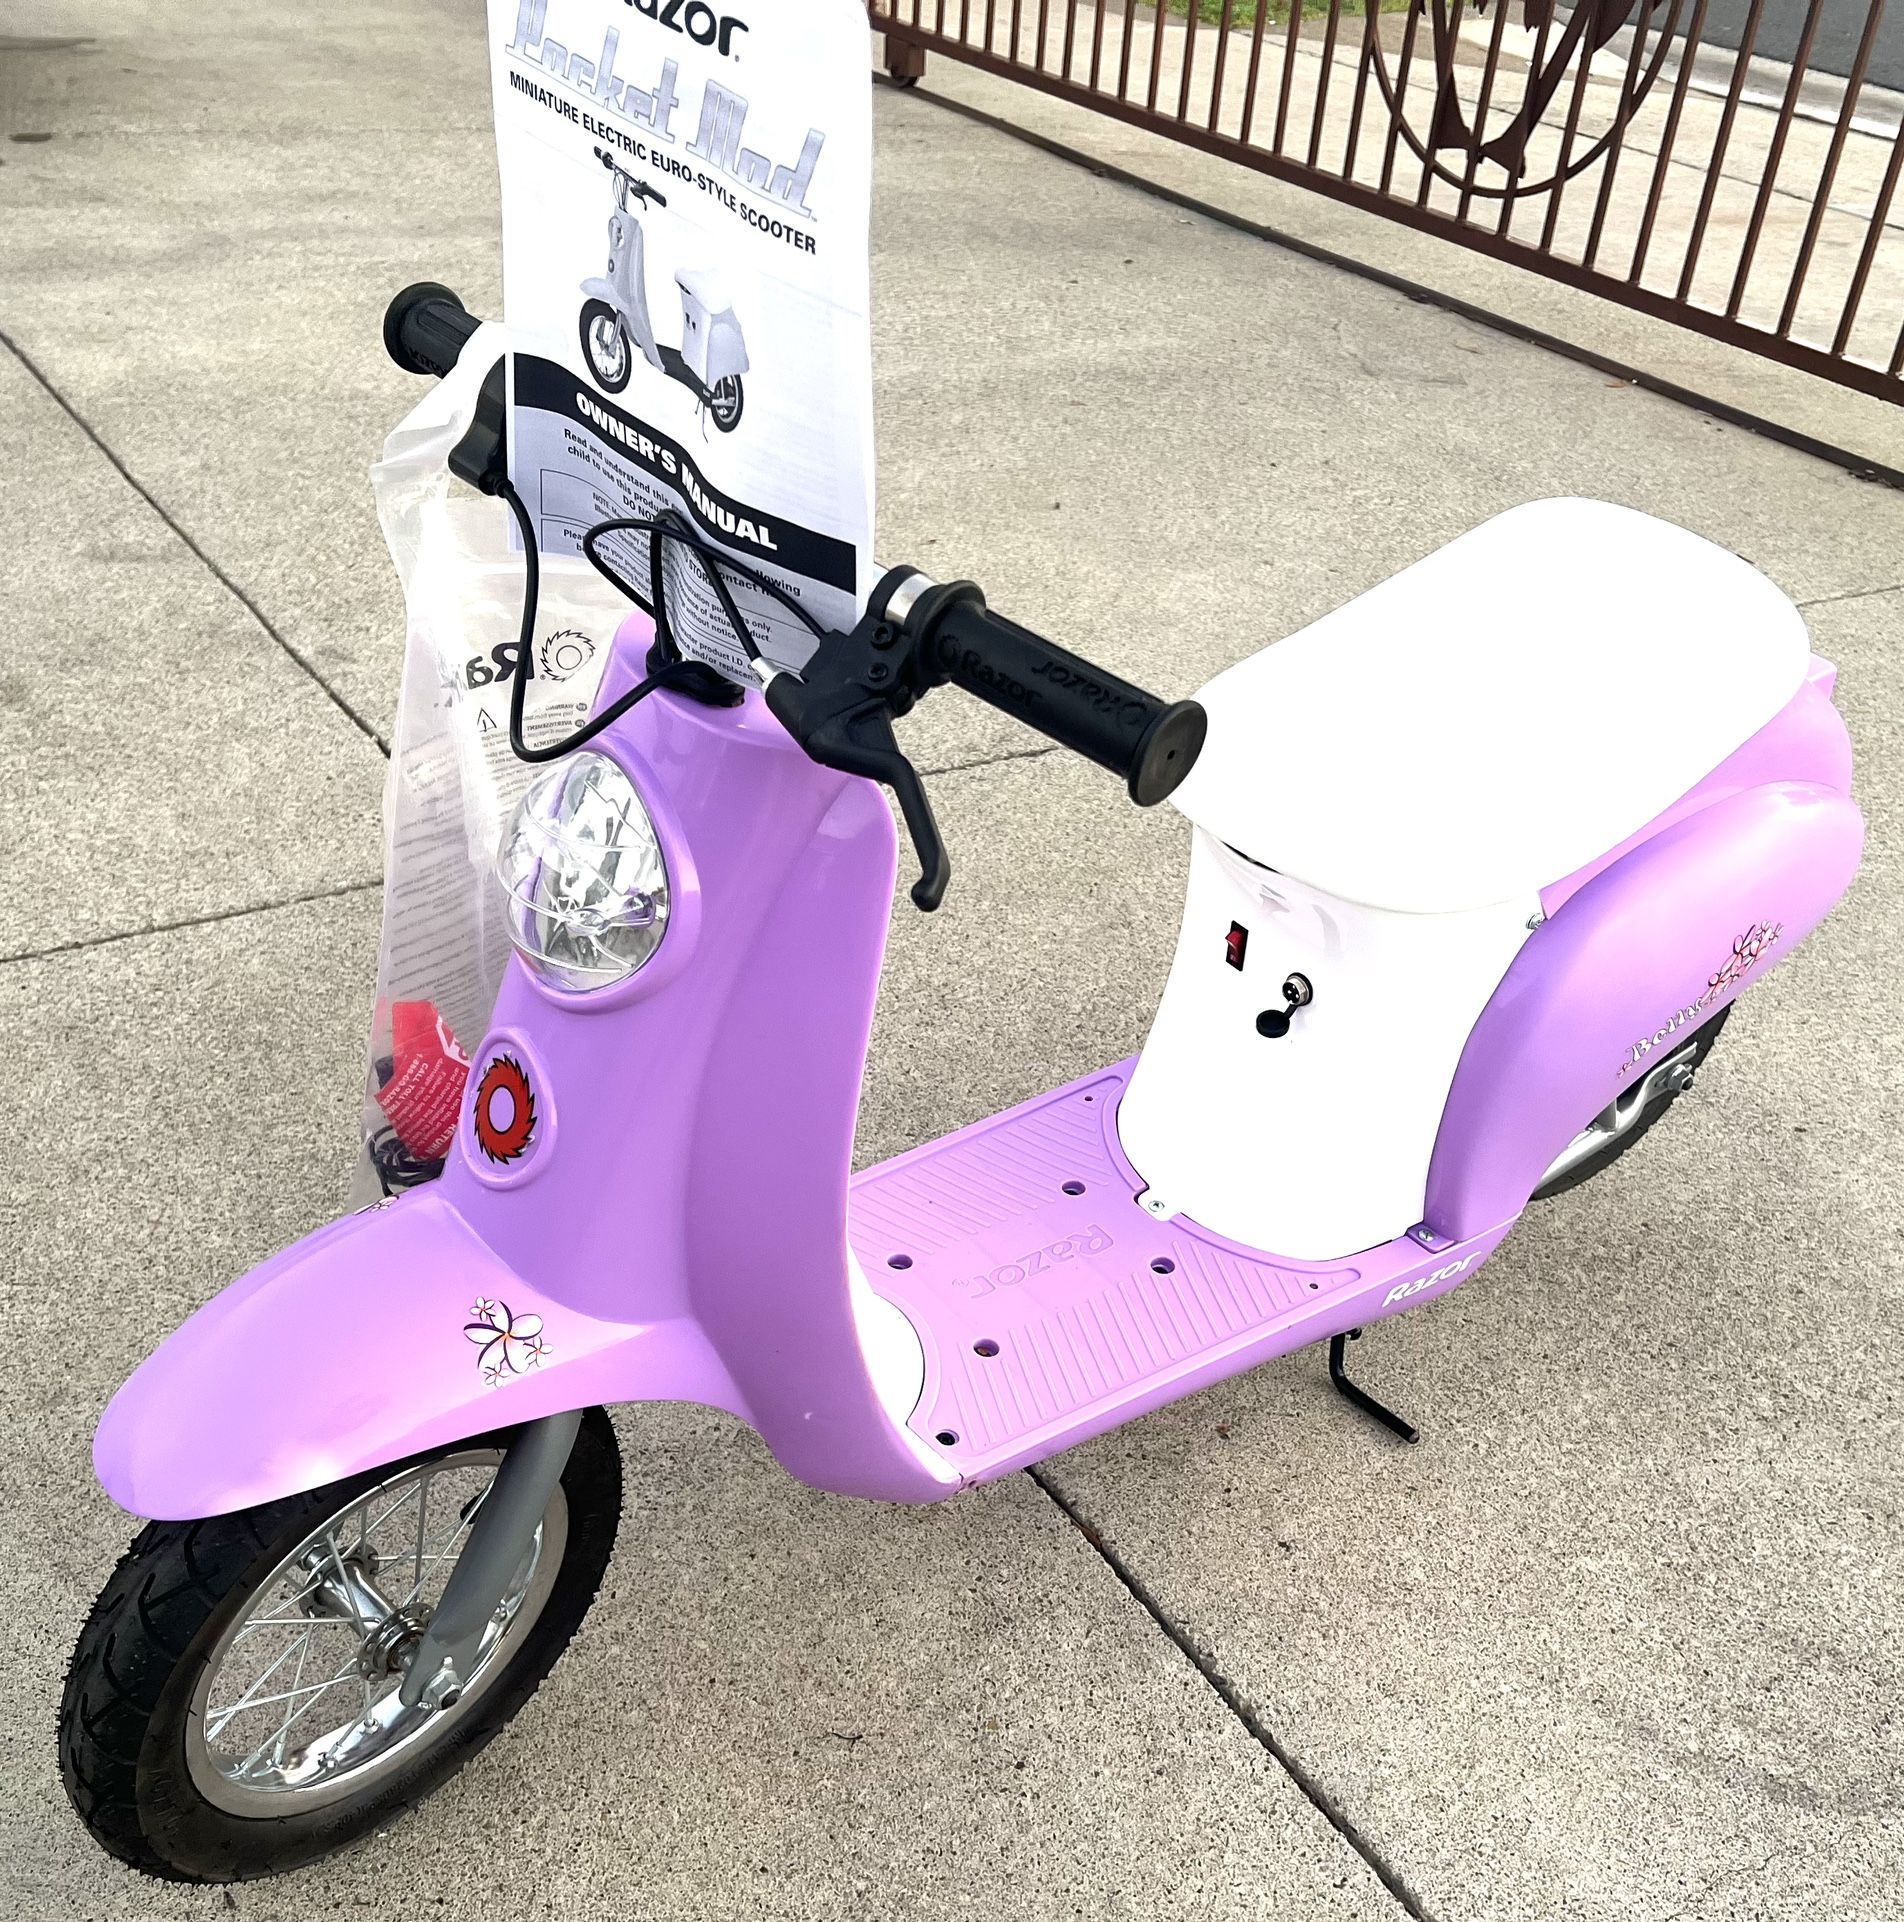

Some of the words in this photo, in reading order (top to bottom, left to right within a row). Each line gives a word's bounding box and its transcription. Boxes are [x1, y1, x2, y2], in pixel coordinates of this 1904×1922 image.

[624, 0, 749, 57] zor
[505, 0, 680, 144] Pocket
[685, 78, 826, 219] Mod
[509, 70, 579, 124] MINIATURE
[582, 112, 647, 161] ELECTRIC
[651, 149, 737, 213] EURO-STYLE
[740, 202, 817, 256] SCOOTER
[564, 428, 587, 448] Read
[590, 445, 603, 460] and
[604, 457, 650, 494] understand
[652, 489, 669, 506] this
[576, 391, 677, 475] OWNER'S
[681, 462, 778, 551] MANUAL
[568, 446, 591, 463] child
[592, 458, 601, 471] to
[602, 468, 615, 483] use
[616, 478, 632, 495] this
[634, 492, 659, 512] produ
[719, 572, 758, 592] ontact
[623, 495, 636, 511] DO
[563, 528, 584, 541] Plea
[709, 613, 732, 627] actua
[960, 652, 1042, 706] Razor
[399, 1084, 416, 1101] TOLL
[413, 1062, 429, 1083] CALL
[971, 1224, 1114, 1299] Razor
[1381, 1251, 1482, 1308] Razor
